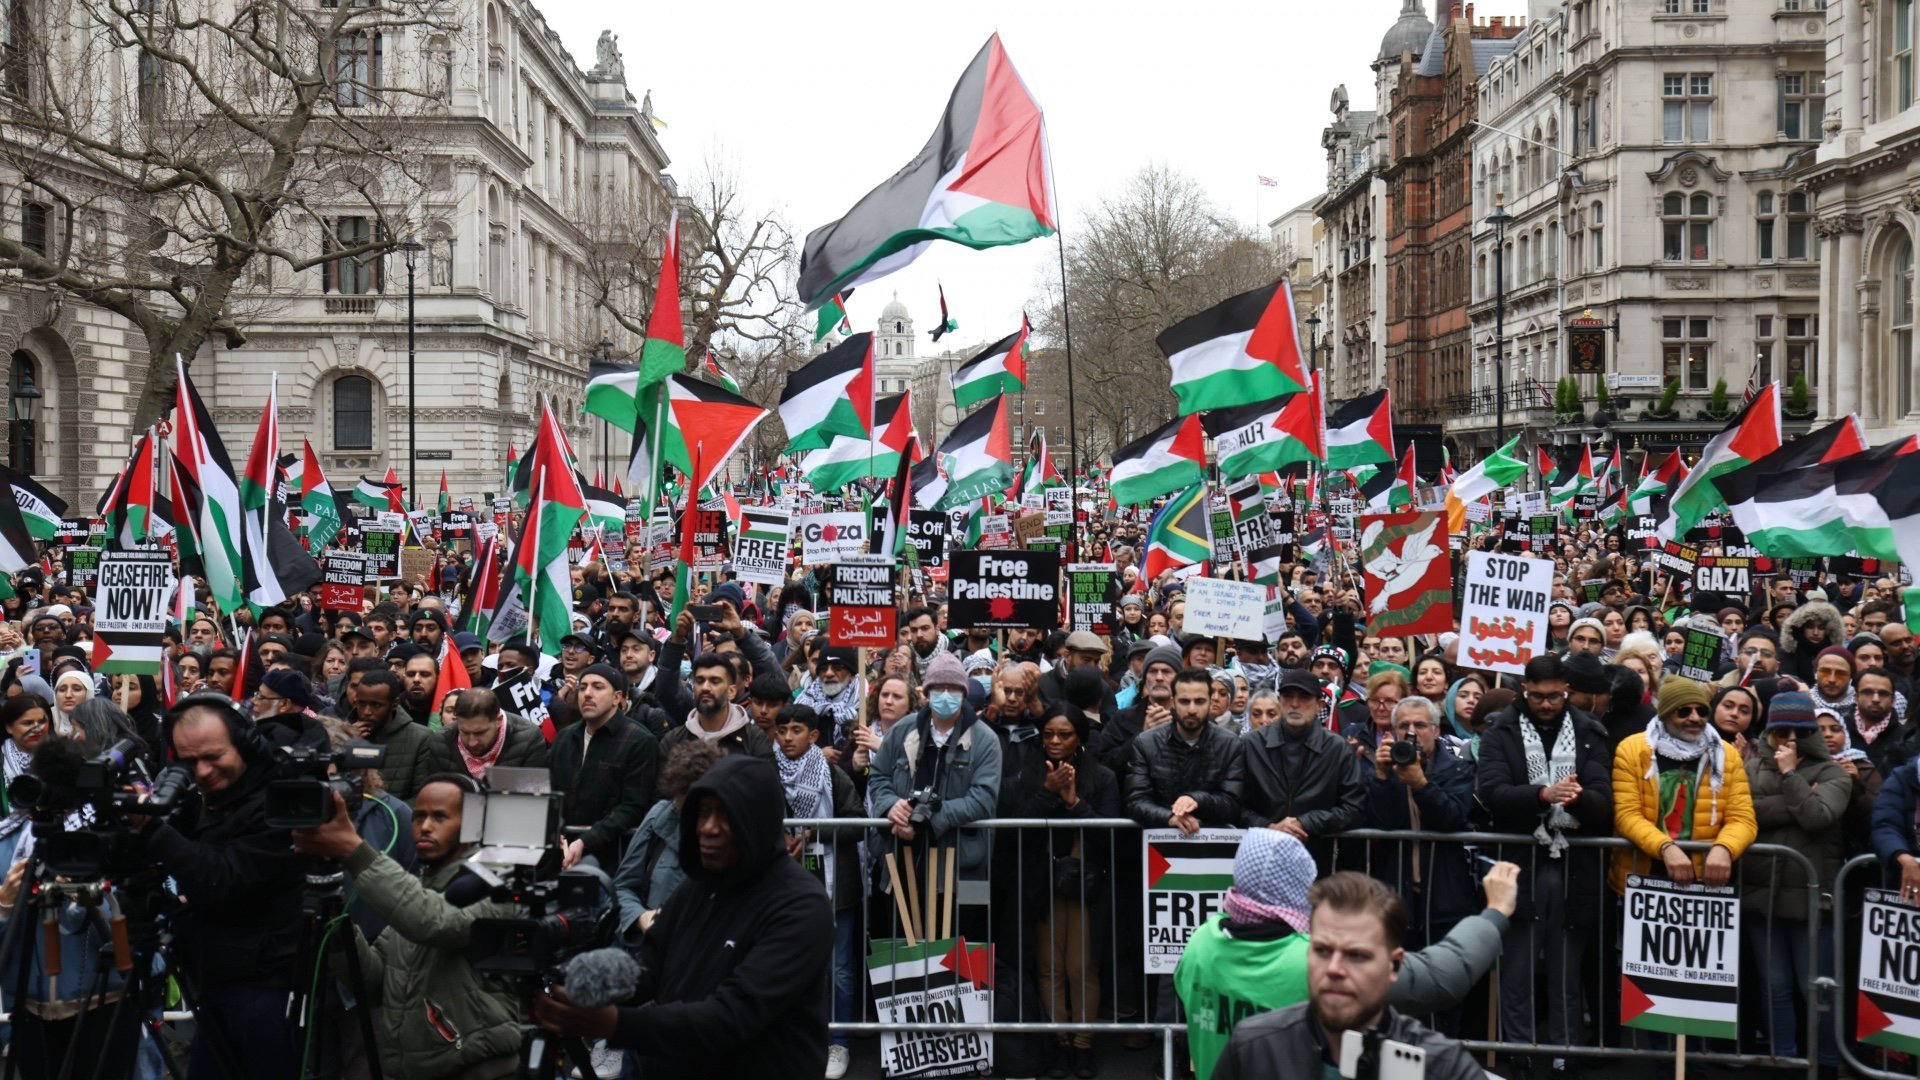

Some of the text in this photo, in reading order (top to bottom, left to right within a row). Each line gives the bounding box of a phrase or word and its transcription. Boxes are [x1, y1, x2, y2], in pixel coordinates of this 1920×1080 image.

[159, 423, 169, 433] A
[1047, 491, 1070, 500] FREE
[801, 507, 822, 515] KILLING
[1330, 504, 1352, 513] FREE
[58, 521, 78, 529] Free
[443, 521, 471, 530] Palestin
[923, 521, 944, 535] Off
[1020, 518, 1040, 530] END
[1236, 514, 1270, 545] FRE
[54, 528, 88, 536] alestine
[1504, 531, 1530, 540] Pales
[1628, 528, 1655, 539] Pales
[1215, 537, 1237, 547] PALEST
[1240, 538, 1270, 556] PALEST
[737, 539, 785, 560] FREE
[1217, 546, 1232, 555] WILL
[1664, 542, 1698, 562] STOP GAZA
[328, 559, 362, 570] FREEDOM
[736, 557, 784, 570] PALESTINE
[1218, 554, 1233, 562] FREE
[1660, 552, 1695, 574] GENOCIDE
[1698, 558, 1749, 567] STOP BOMBING
[979, 556, 1028, 577] Free
[1486, 558, 1530, 582] STOP
[1789, 569, 1817, 577] PALESTINE
[102, 564, 169, 587] CEASEFIRE
[326, 572, 362, 585] PALESTINE
[836, 566, 889, 583] FREEDOM
[1074, 573, 1109, 582] FROM THE
[1697, 567, 1749, 592] GAZA
[953, 578, 1053, 600] Palestine
[1074, 583, 1106, 592] RIVER TO
[834, 588, 892, 605] PALESTINE
[1074, 594, 1103, 602] THE SEA
[1470, 584, 1546, 613] THE WAR
[106, 588, 162, 620] NOW!
[1074, 603, 1112, 613] PALESTINE
[843, 610, 882, 626] الحرية
[1074, 613, 1102, 623] WILL BE
[132, 622, 142, 630] END
[838, 626, 887, 639] لفلسطين
[1075, 624, 1091, 632] FREE
[1470, 616, 1535, 647] أوقفوا
[1706, 634, 1719, 648] THE
[1468, 647, 1532, 666] الحرب
[1704, 646, 1713, 659] TO
[1684, 654, 1708, 669] THE SEA
[1682, 664, 1714, 682] PALESTINE
[510, 680, 540, 709] Fr
[1644, 879, 1672, 888] PALESTINE
[1149, 892, 1226, 926] FRE
[1630, 892, 1735, 930] CEASEFIRE
[1150, 946, 1185, 954] END ISRA
[1640, 923, 1725, 970] NOW!
[1626, 962, 1734, 982] FREE PALESTINE END APARTHEID
[958, 986, 972, 994] FREE
[1863, 978, 1919, 998] FREE PALESTINE
[890, 1032, 981, 1073] CEASEFIRE
